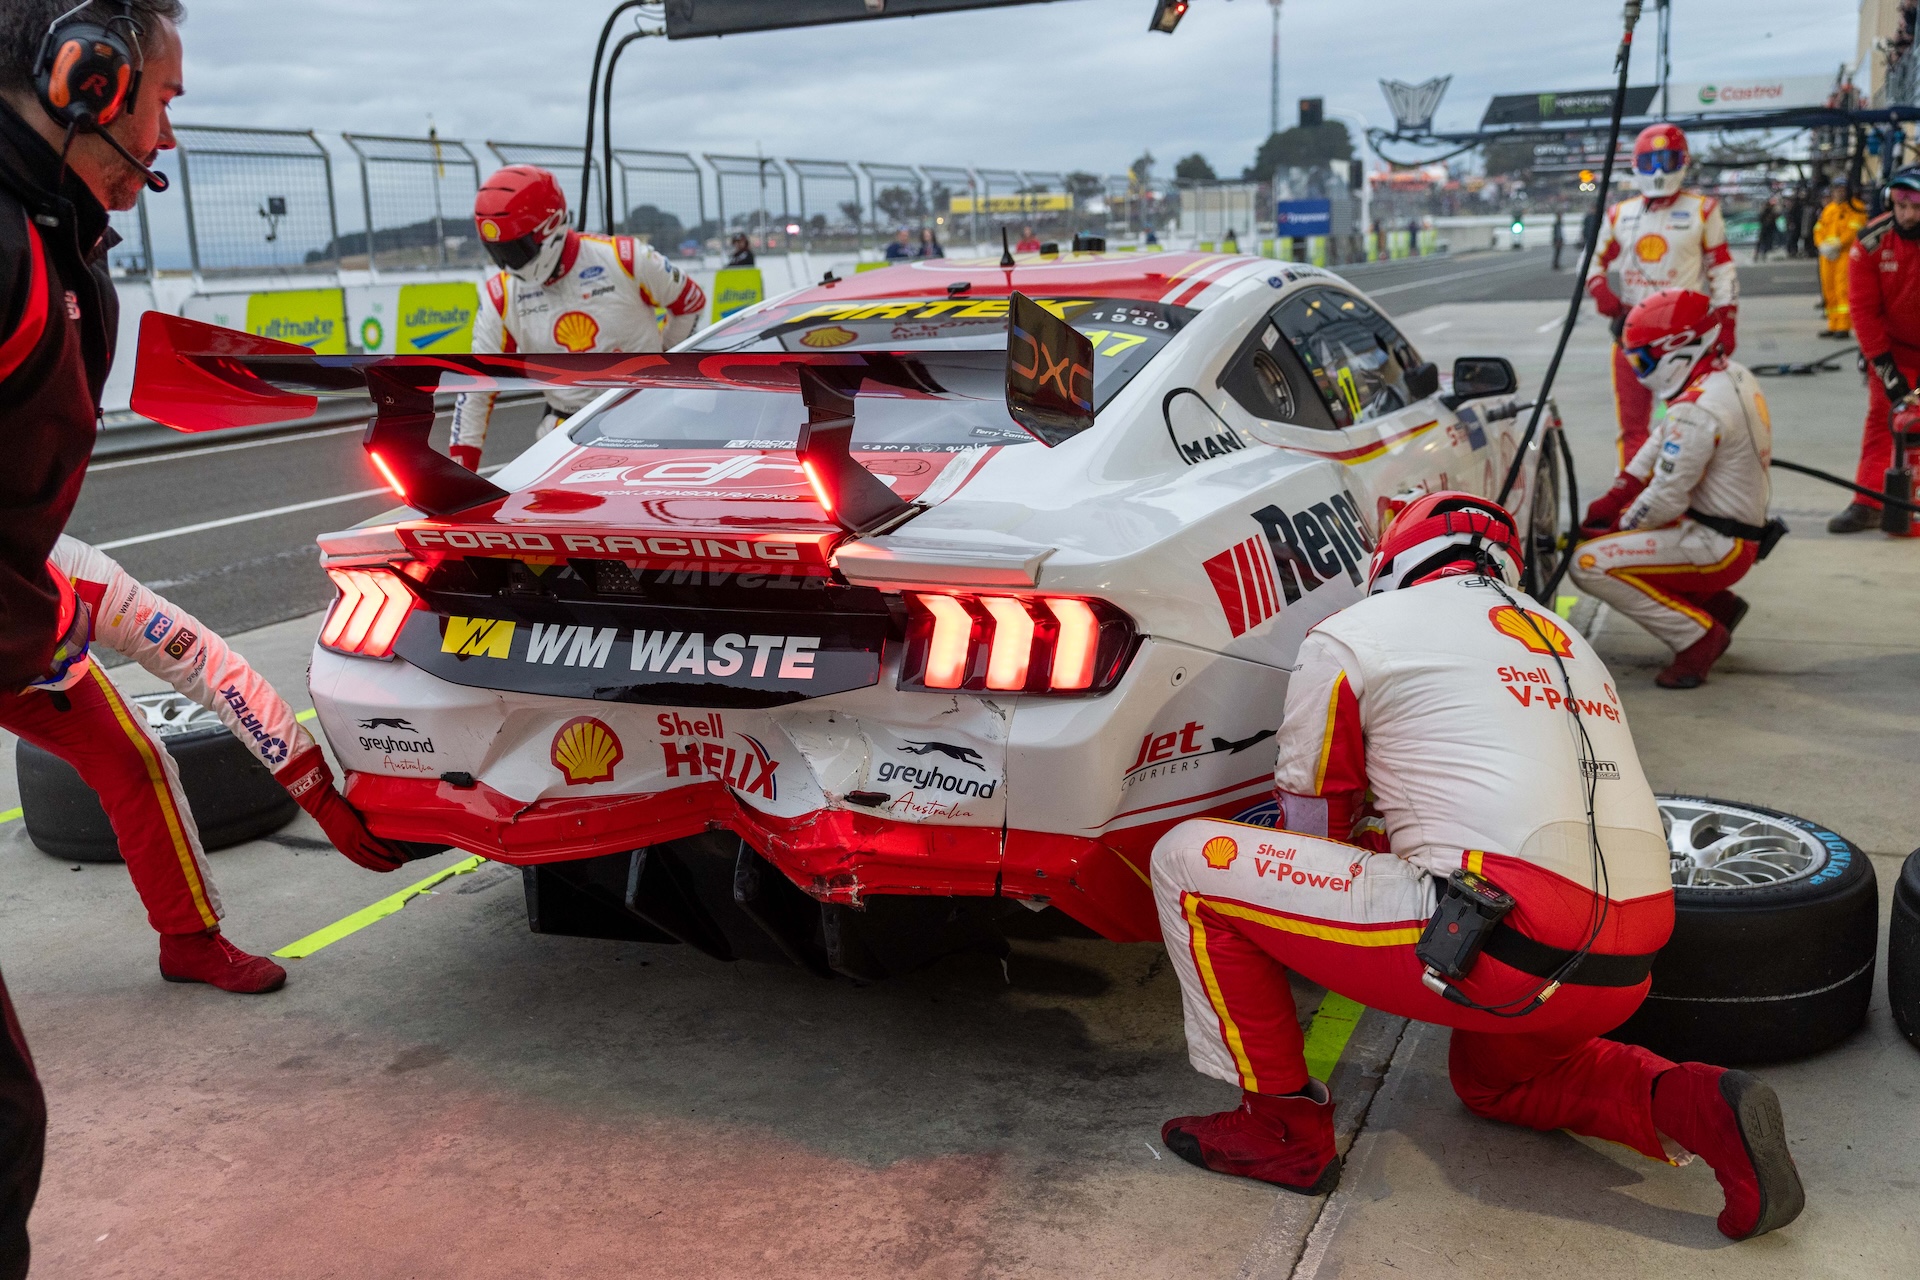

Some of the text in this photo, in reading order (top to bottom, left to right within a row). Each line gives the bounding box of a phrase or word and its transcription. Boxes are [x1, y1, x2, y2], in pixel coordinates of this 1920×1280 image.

[1720, 83, 1783, 102] Castrol
[717, 287, 758, 303] ultimate
[405, 305, 471, 327] ultimate
[1092, 311, 1169, 330] 1980
[1116, 308, 1158, 319] EST.
[256, 316, 334, 338] ultimate
[1084, 330, 1148, 357] 17
[1012, 325, 1092, 411] DXC
[975, 428, 1000, 437] Terry
[862, 444, 911, 453] camp
[1181, 431, 1242, 465] MAN
[638, 490, 727, 498] JOHNSON
[722, 491, 800, 501] RACING
[412, 529, 800, 561] FORD RACING
[119, 600, 130, 614] WM
[170, 630, 194, 655] OTR
[525, 622, 821, 680] WM WASTE
[1497, 665, 1553, 685] Shell
[219, 684, 270, 743] PIRTEK
[1506, 685, 1621, 724] V-Power
[657, 713, 725, 739] Shell
[359, 735, 435, 754] greyhound
[1124, 721, 1204, 775] Jet
[383, 754, 435, 773] Australia
[660, 741, 780, 800] HELIX
[1121, 758, 1200, 791] COURIERS
[1581, 761, 1616, 772] rpm
[876, 761, 997, 799] greyhound
[887, 790, 974, 819] Australia
[1256, 844, 1296, 861] Shell
[1254, 857, 1353, 893] V-Power
